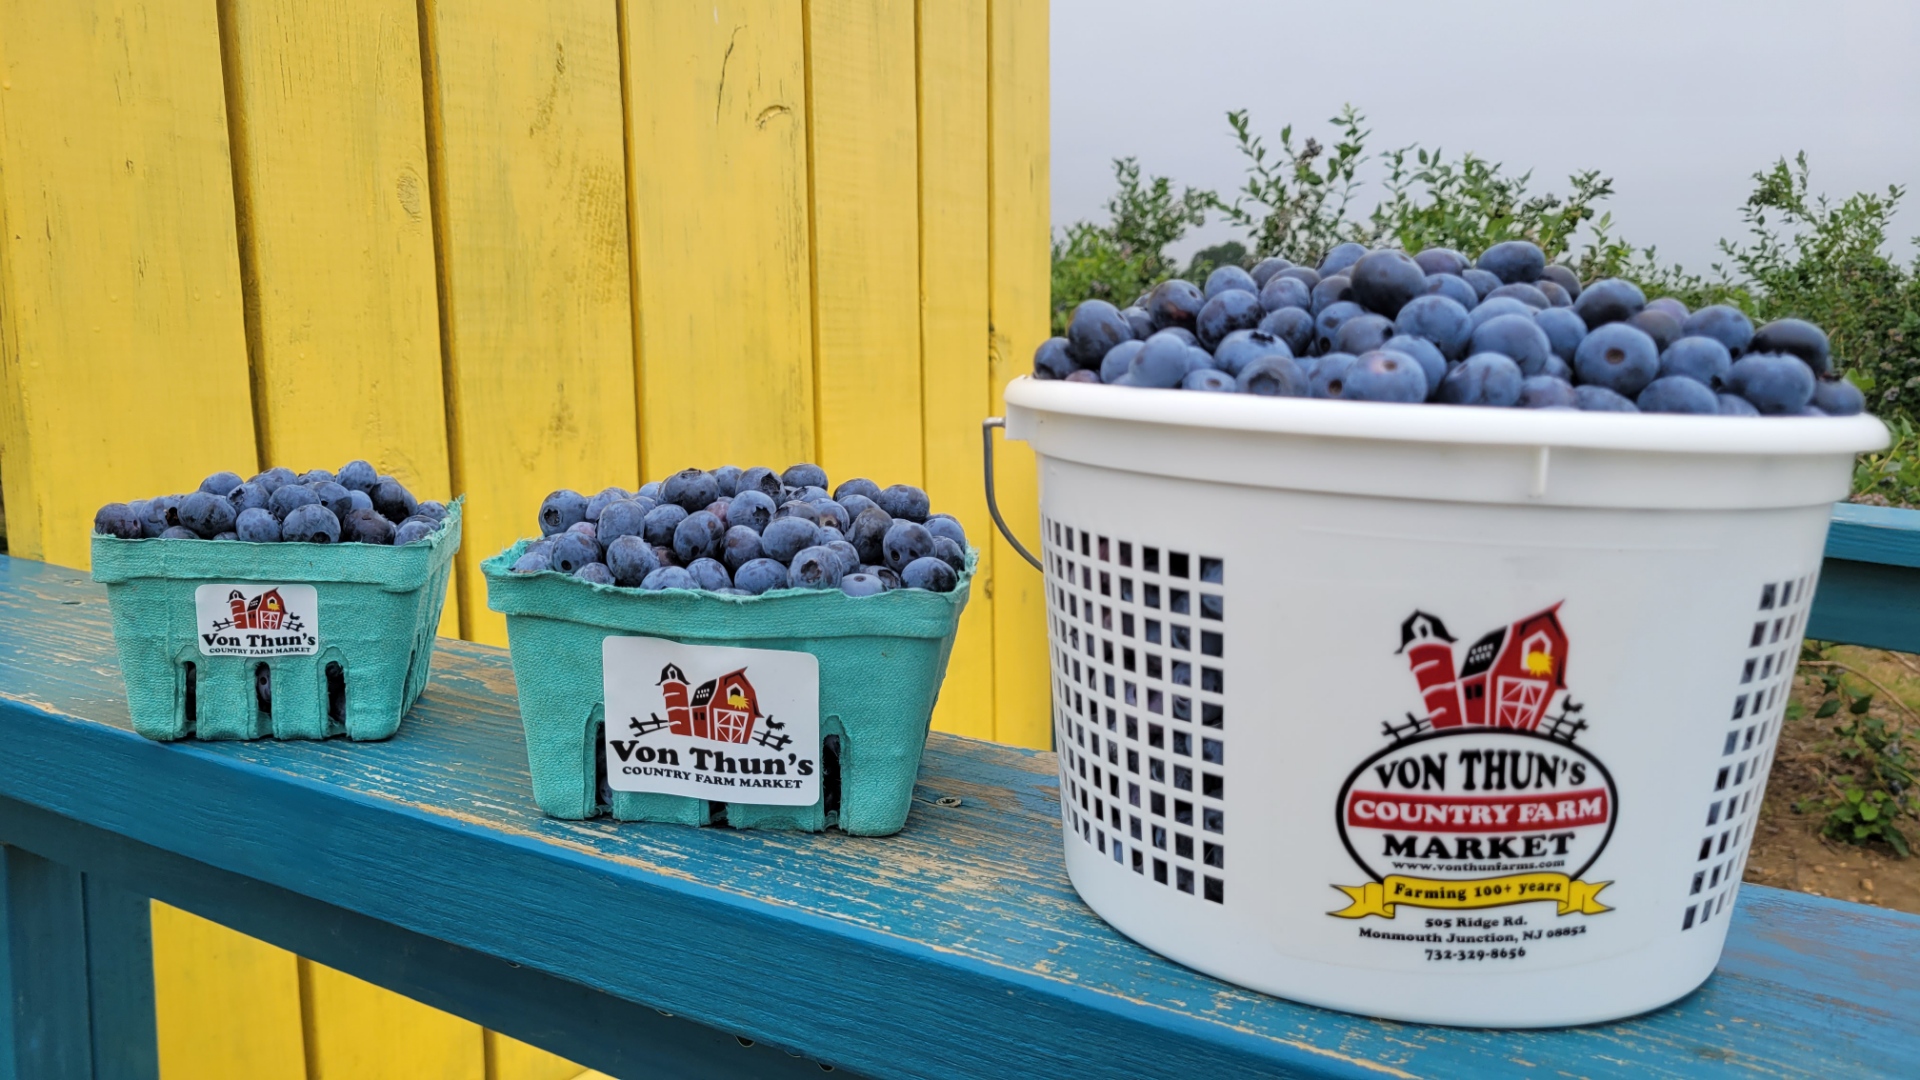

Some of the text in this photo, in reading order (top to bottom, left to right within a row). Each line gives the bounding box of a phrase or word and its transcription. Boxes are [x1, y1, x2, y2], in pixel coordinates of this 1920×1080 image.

[202, 633, 316, 647] Von Thun's
[209, 647, 247, 655] COUNTRY
[609, 740, 814, 776] Von Thun's
[622, 766, 803, 789] COUNTRY FARM MARKET
[1374, 752, 1447, 791] VON
[1353, 796, 1603, 825] COUNTRY FARM
[1382, 833, 1575, 859] MARKET
[1391, 859, 1566, 872] www.vonthunfarms.com
[1394, 882, 1562, 901] Farming 100+ years
[1424, 916, 1528, 928] 505 Ridge Rd.
[1358, 925, 1587, 944] Monmouth Junction, NJ 08852
[1424, 947, 1526, 961] 732-329-8656
